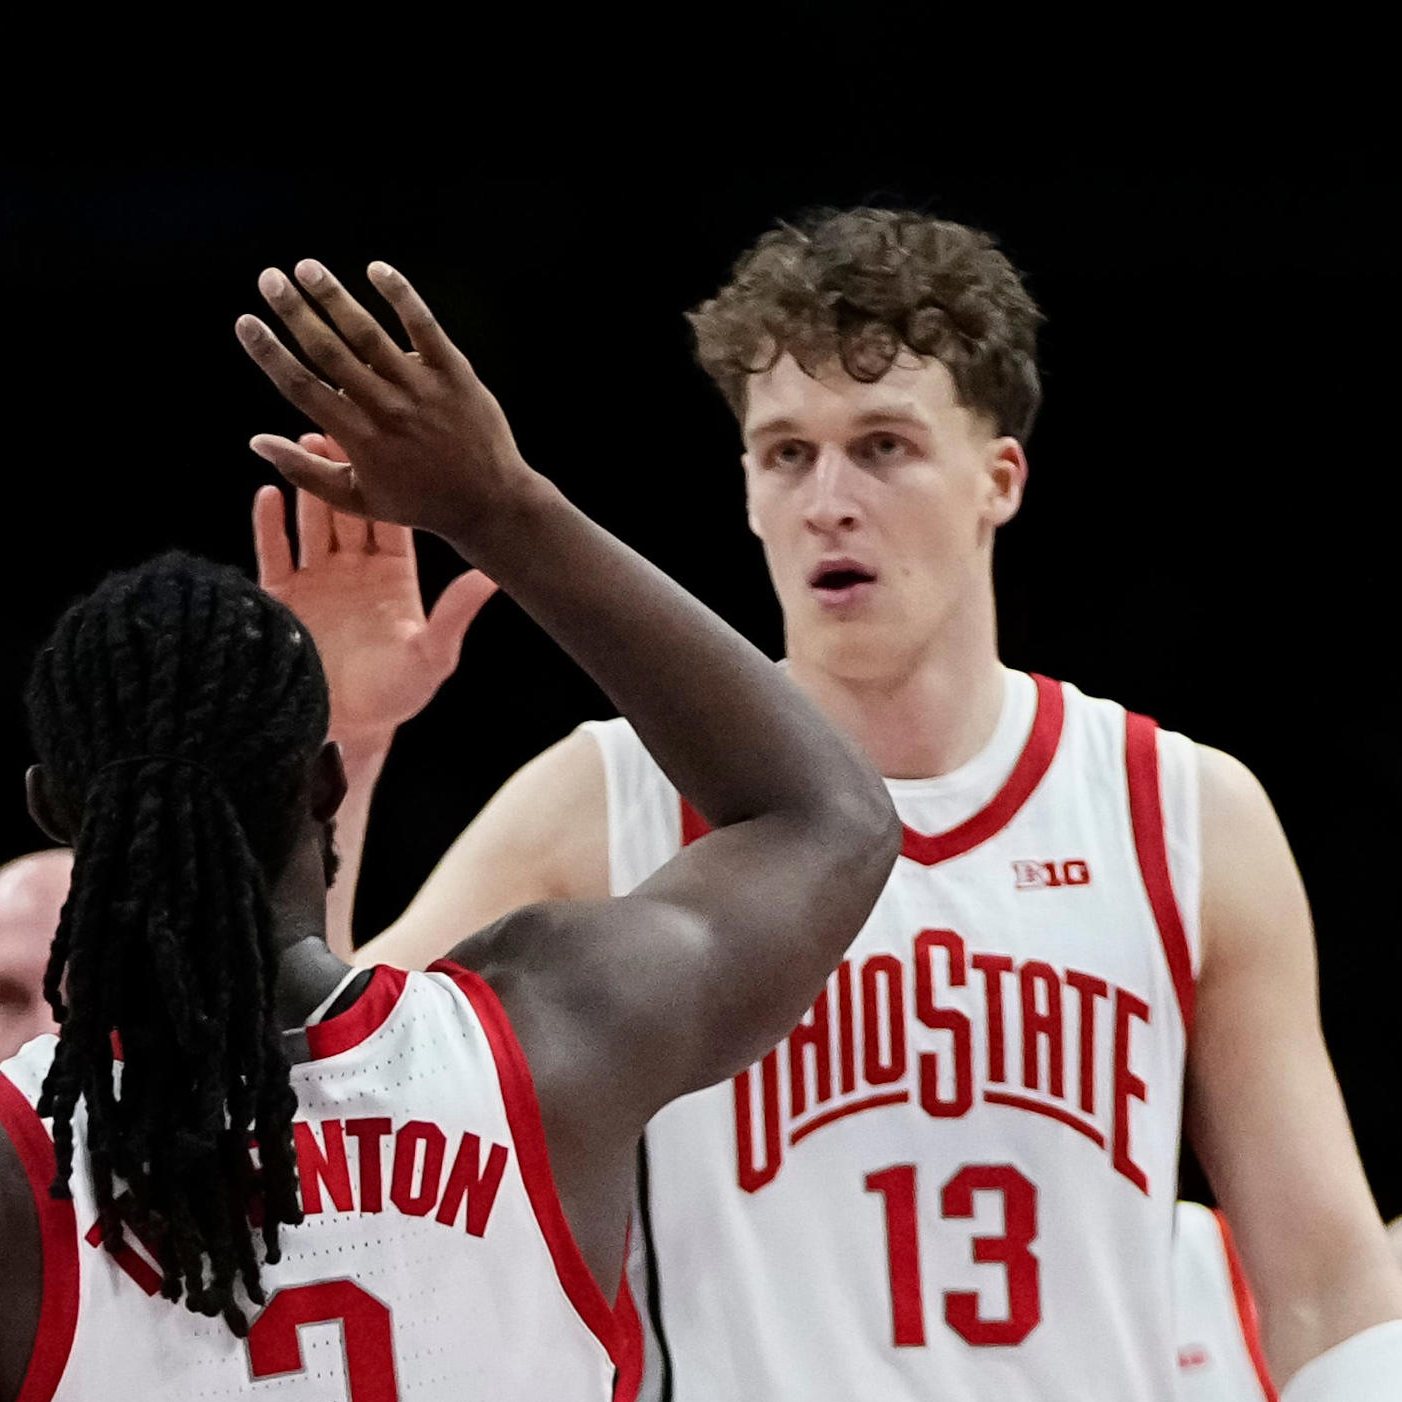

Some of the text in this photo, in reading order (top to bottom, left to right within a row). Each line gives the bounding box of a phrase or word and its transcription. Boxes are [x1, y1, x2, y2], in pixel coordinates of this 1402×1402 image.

[733, 927, 1150, 1196] OHIO STATE
[865, 1164, 1042, 1348] 13
